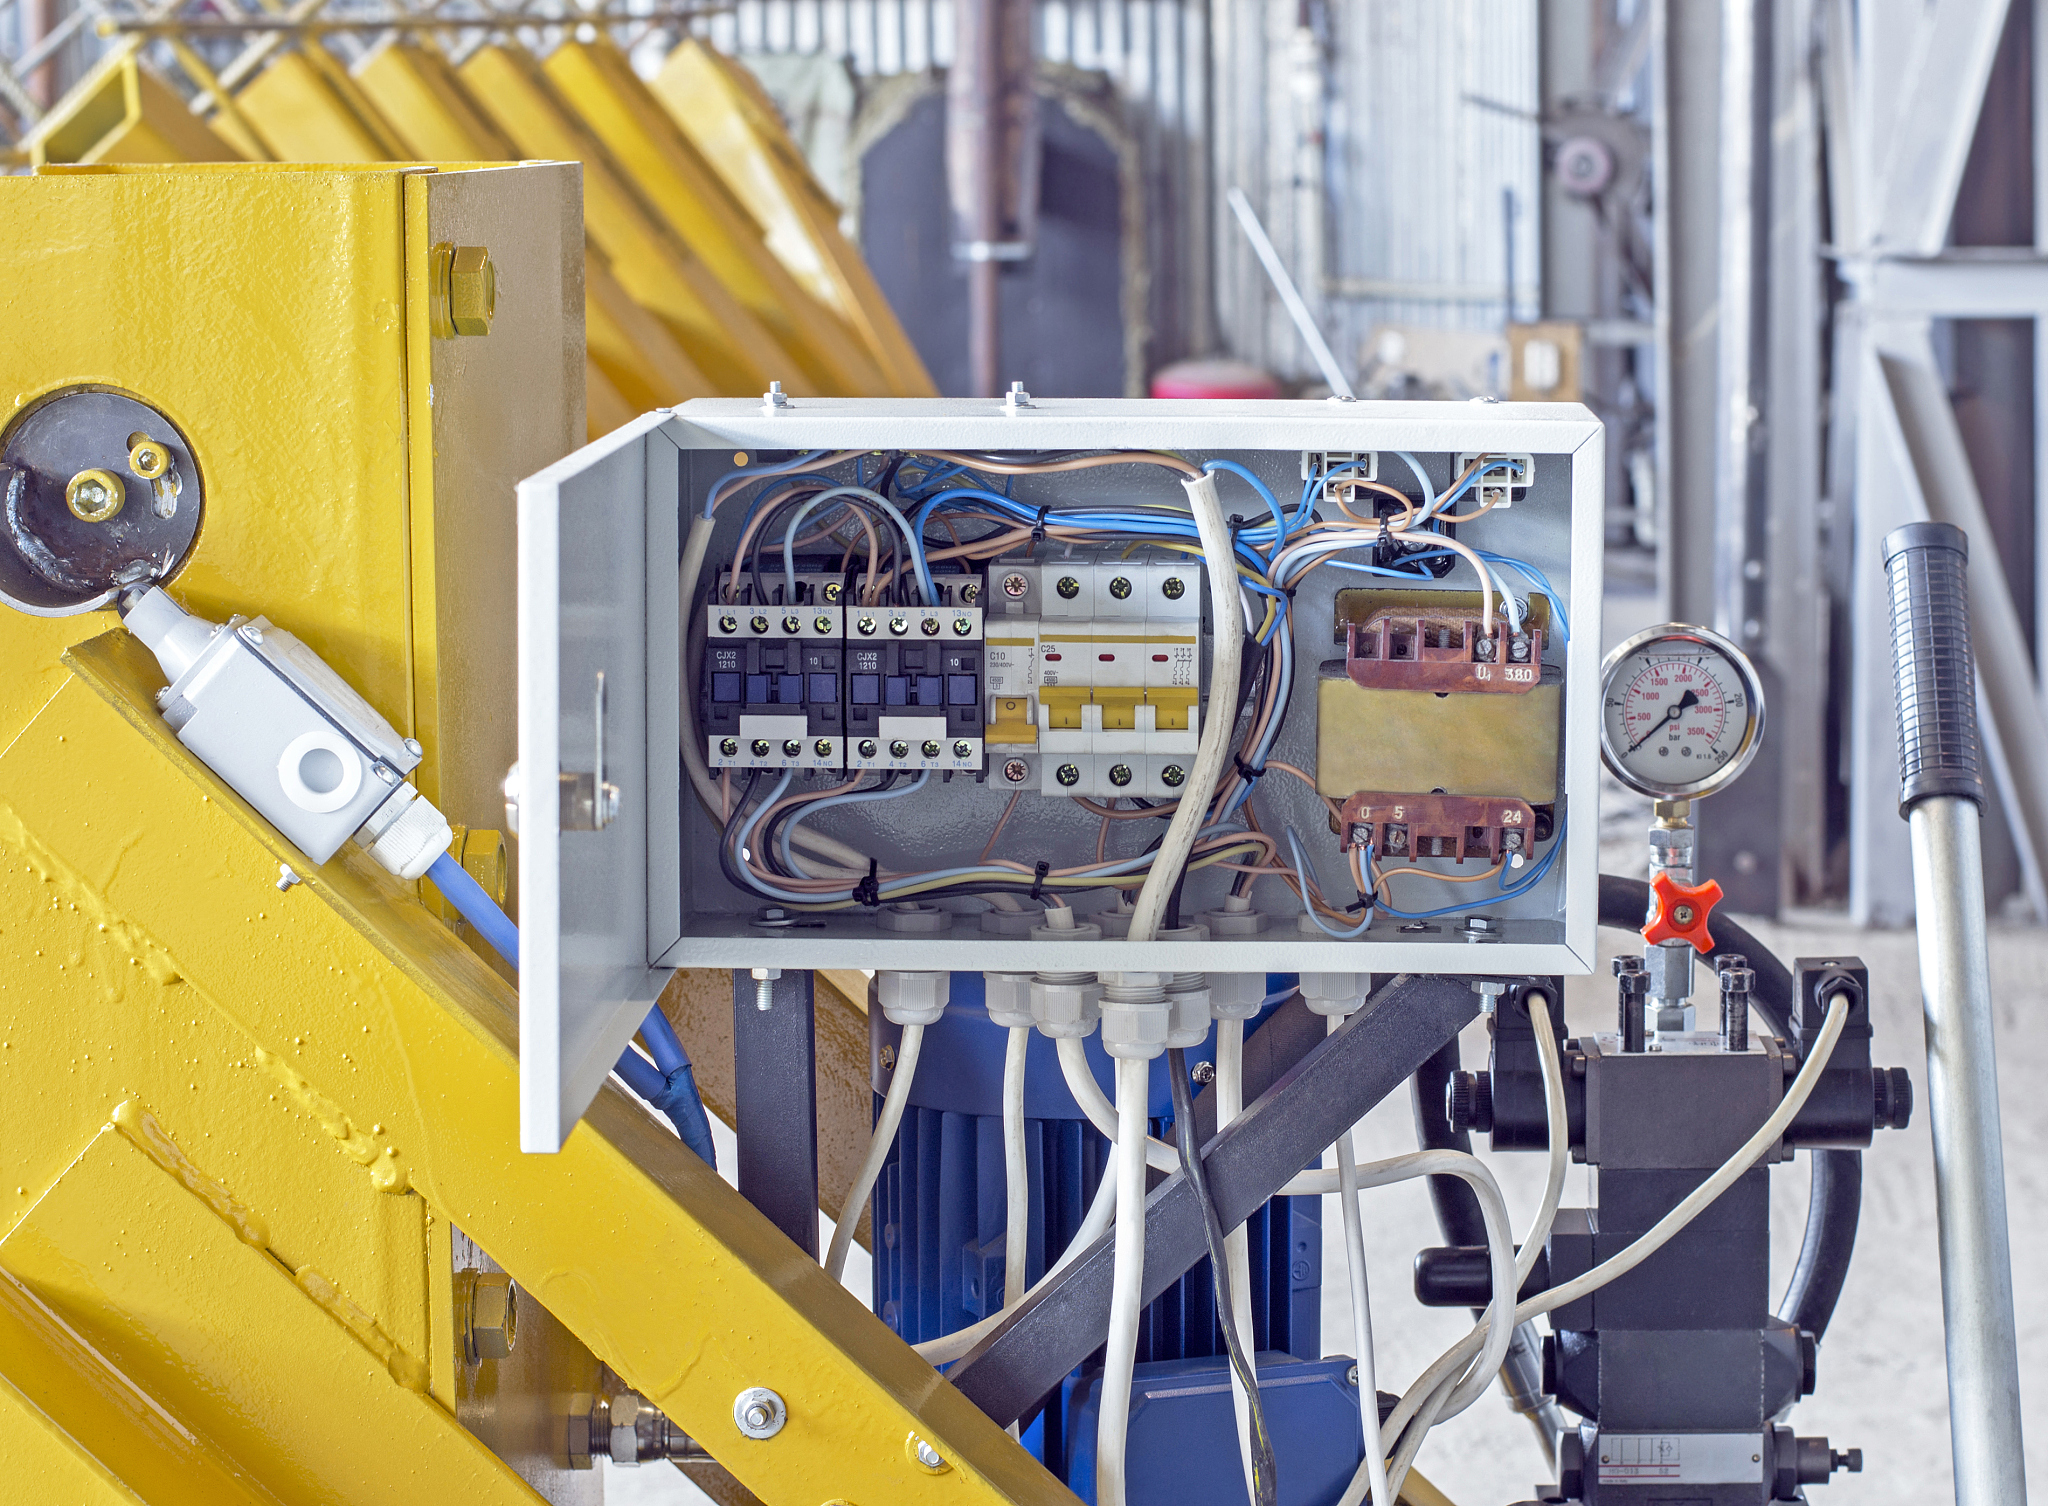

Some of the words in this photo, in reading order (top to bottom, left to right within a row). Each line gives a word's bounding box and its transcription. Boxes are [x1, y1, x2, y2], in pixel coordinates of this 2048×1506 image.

[1041, 645, 1056, 653] C25
[716, 651, 736, 659] CJX2
[857, 652, 877, 661] CJX2
[990, 651, 1006, 660] C10
[718, 660, 736, 669] 1210
[810, 657, 818, 665] 10
[859, 661, 877, 670] 1210
[950, 658, 959, 667] 10
[1505, 667, 1532, 681] 380
[1674, 674, 1692, 683] 2000
[1650, 678, 1668, 686] 1500
[1642, 692, 1659, 700] 1000
[1734, 693, 1743, 708] 200
[1606, 697, 1614, 708] 50
[1694, 706, 1712, 714] 3000
[1637, 713, 1651, 721] 500
[1669, 723, 1680, 732] psi
[1687, 727, 1705, 735] 3500
[1715, 750, 1729, 764] 250
[1361, 806, 1370, 819] 0
[1394, 805, 1403, 819] 5
[1503, 810, 1522, 824] 24
